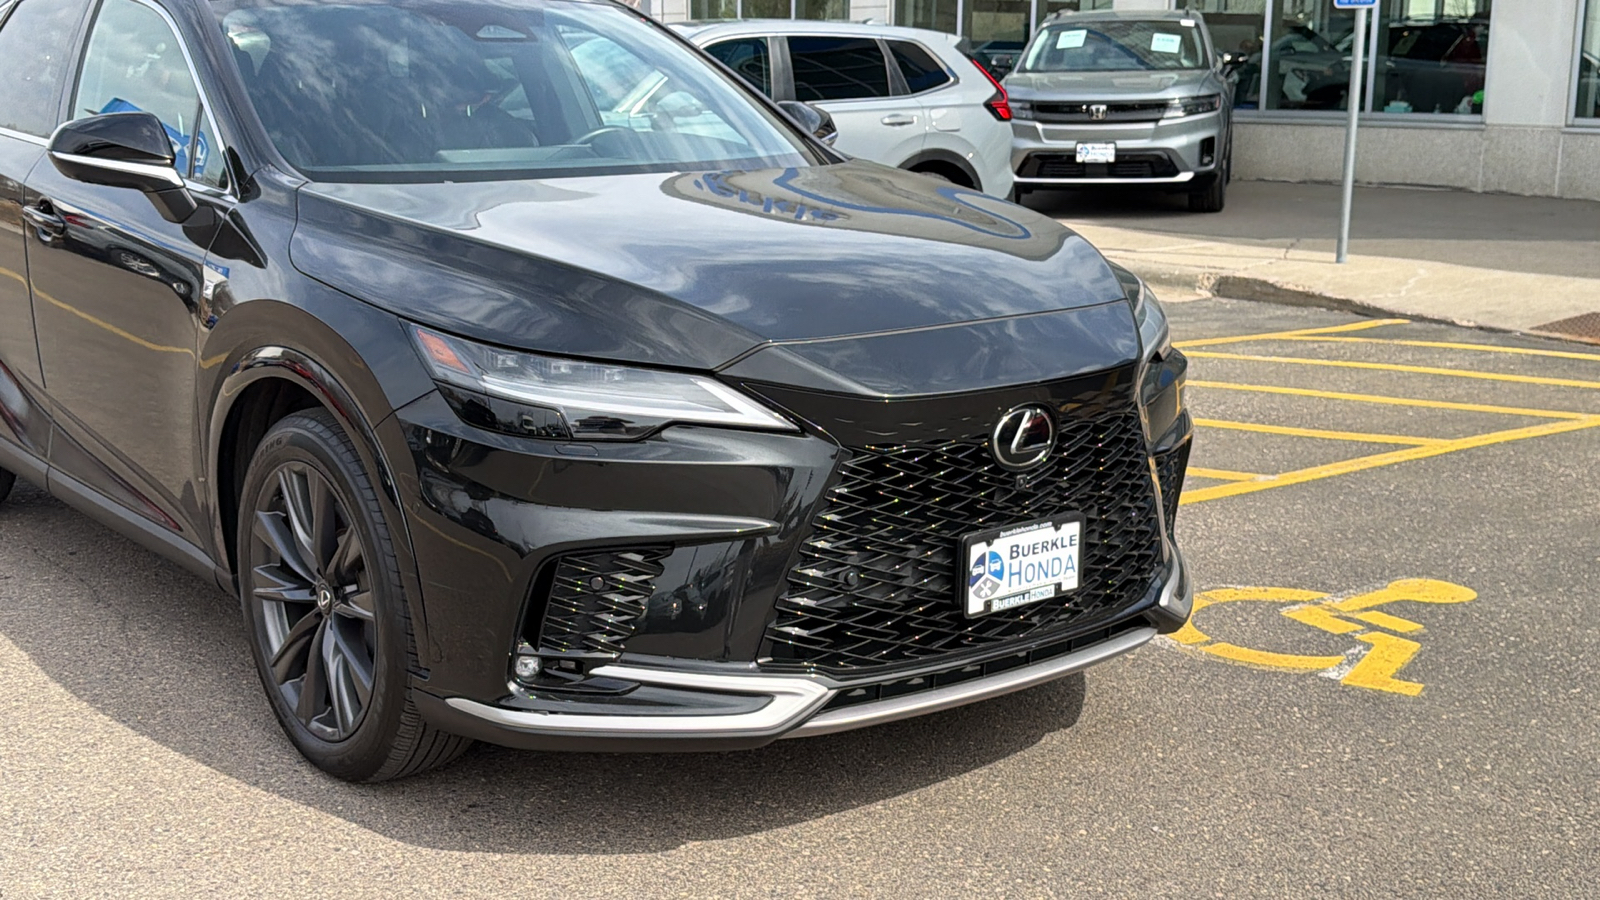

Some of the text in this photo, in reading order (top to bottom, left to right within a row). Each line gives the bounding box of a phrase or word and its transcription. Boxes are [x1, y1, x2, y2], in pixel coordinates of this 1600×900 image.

[1009, 534, 1078, 560] BUERKLE
[1008, 554, 1076, 588] HONDA
[993, 588, 1053, 610] BUERKLE HONDA
